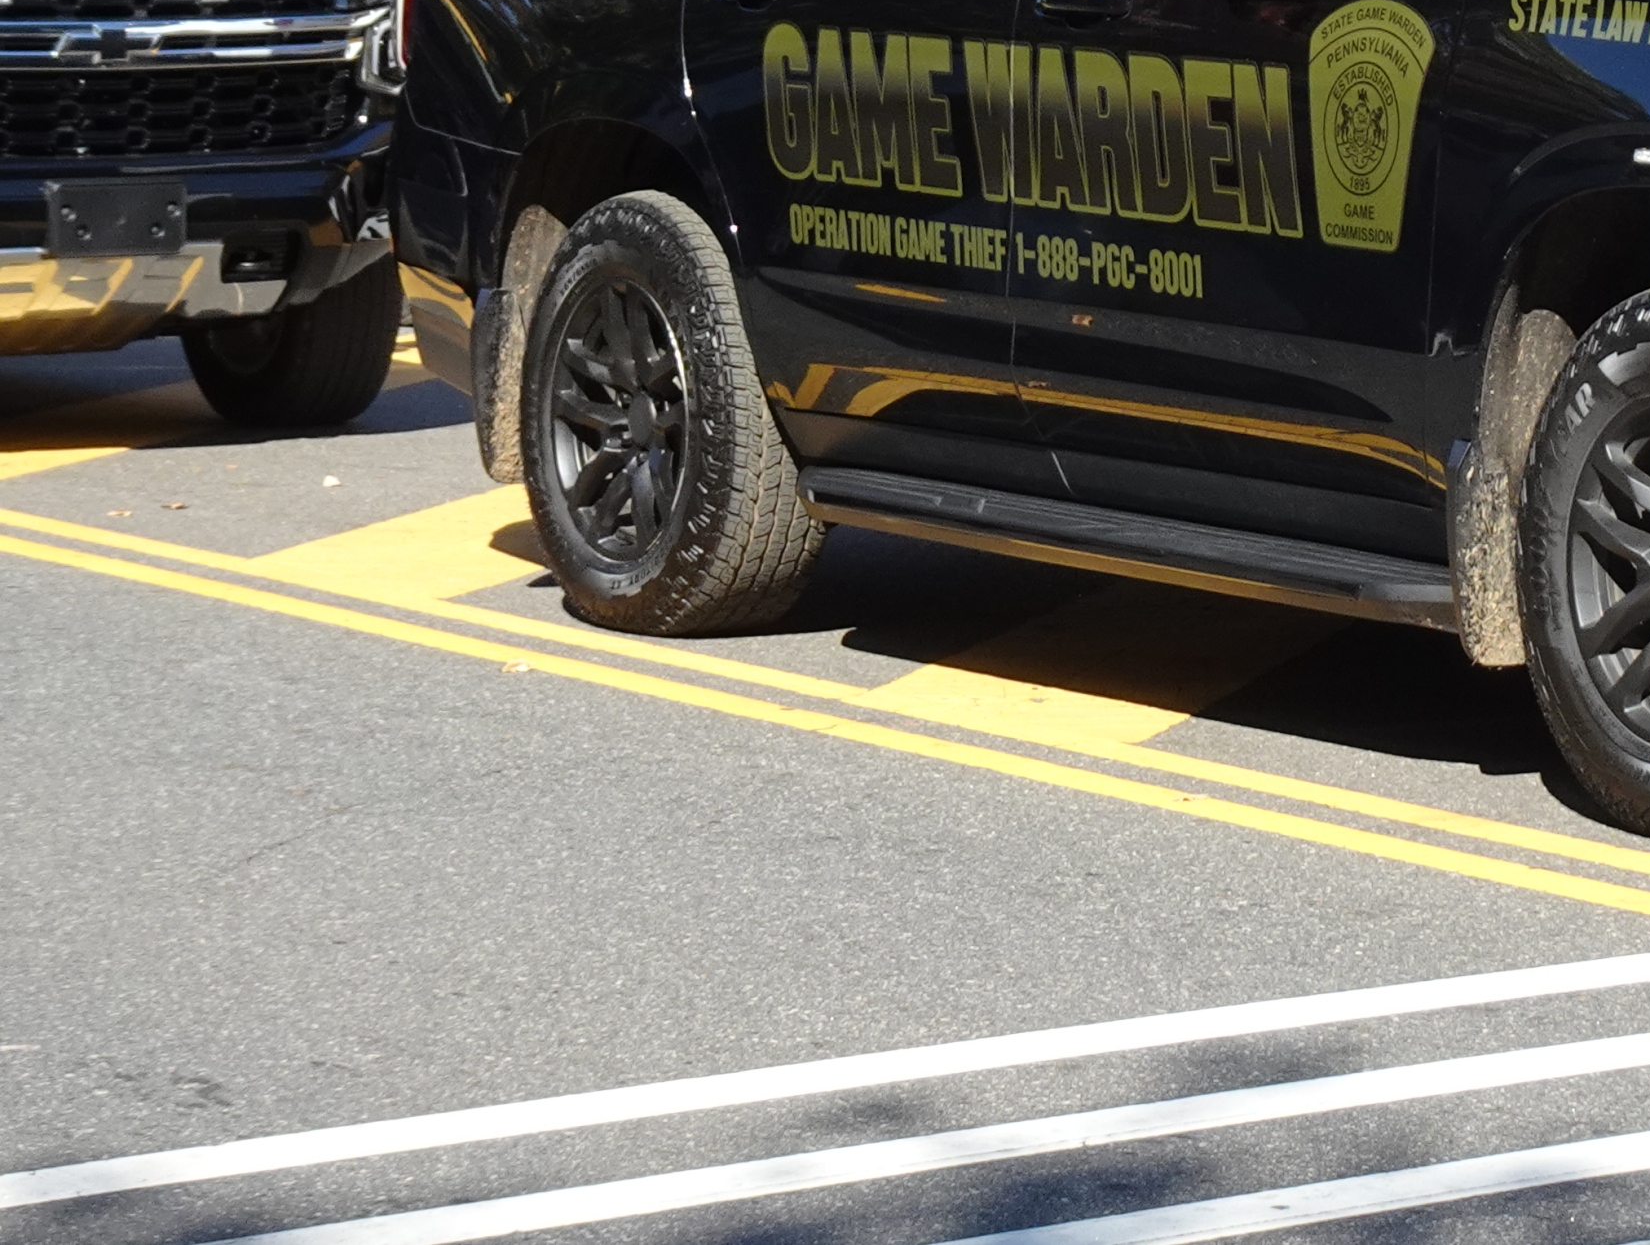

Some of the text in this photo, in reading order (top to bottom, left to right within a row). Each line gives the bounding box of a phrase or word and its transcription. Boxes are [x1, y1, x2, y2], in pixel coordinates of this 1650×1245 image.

[1320, 7, 1426, 50] STATE GAME WARDEN
[1326, 36, 1410, 78] PENNSYLVANIA
[1332, 66, 1394, 107] ESTABLISHED
[763, 21, 1303, 238] GAME WARDEN
[1350, 176, 1371, 192] 1895
[1344, 202, 1375, 221] GAME
[789, 203, 1203, 299] OPERATION GAME THIEF 1-888-PGC-8001
[1325, 222, 1393, 245] COMMISSION
